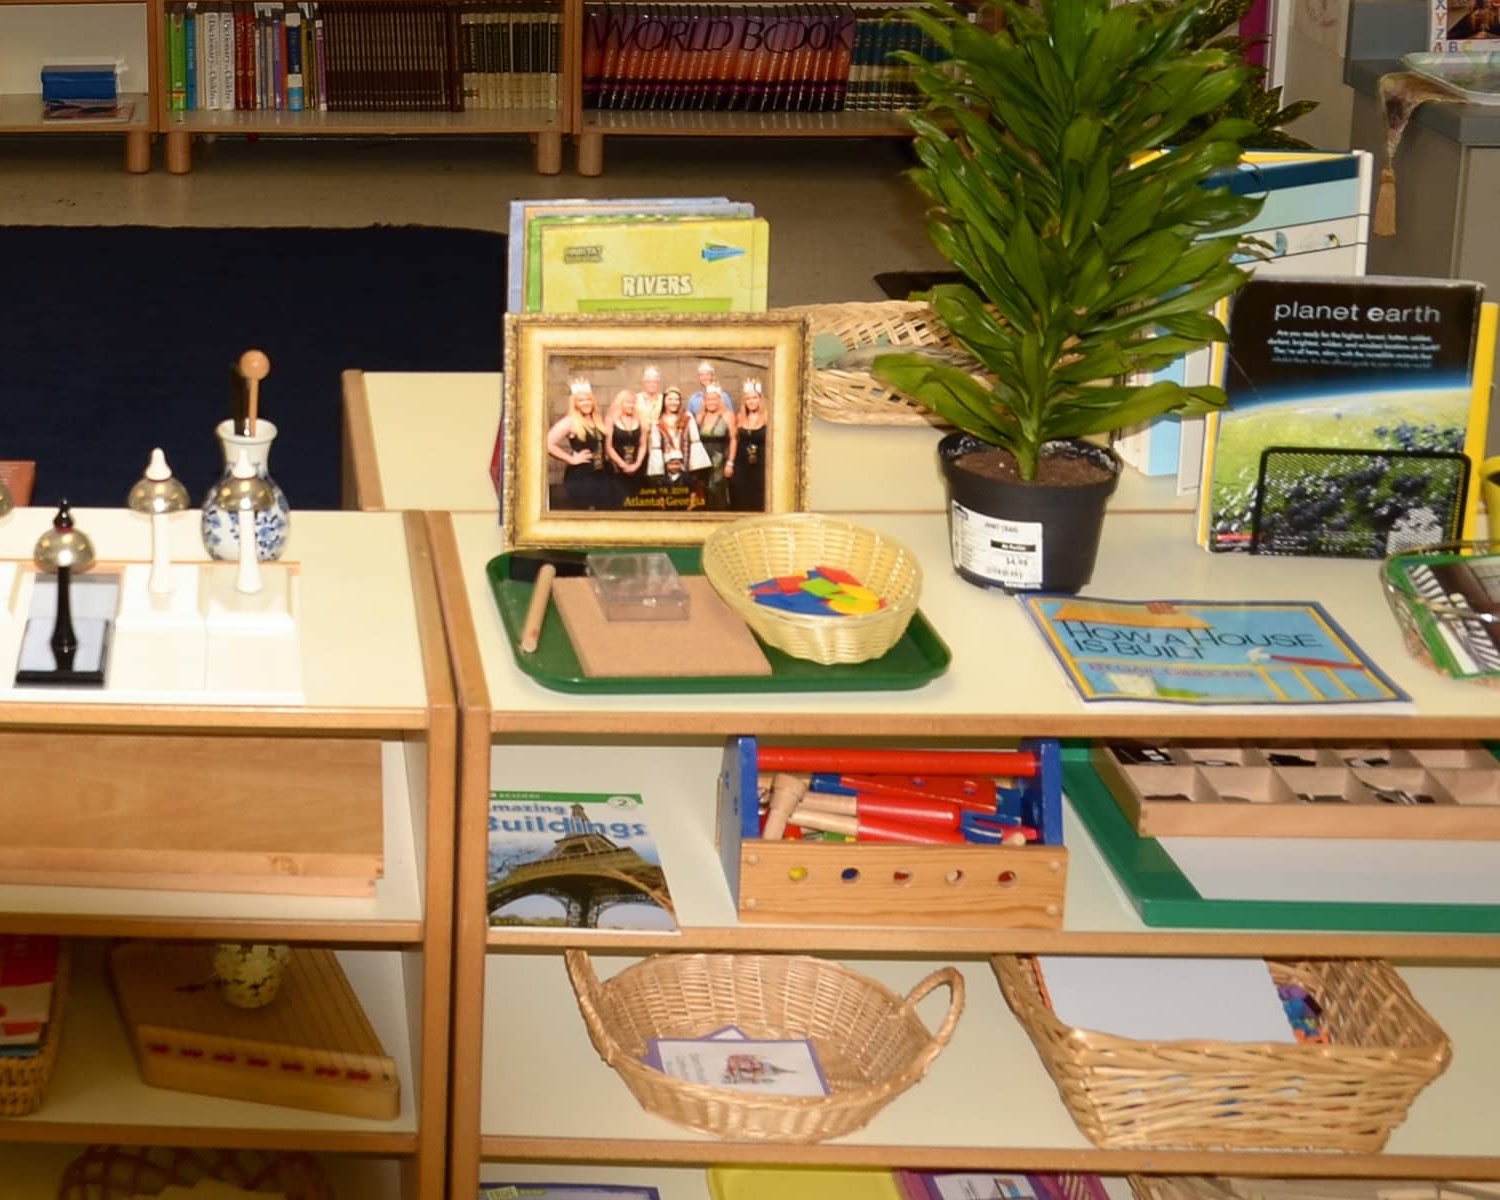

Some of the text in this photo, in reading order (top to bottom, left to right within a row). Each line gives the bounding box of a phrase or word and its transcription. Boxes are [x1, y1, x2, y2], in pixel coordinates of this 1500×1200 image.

[621, 274, 693, 297] RIVERS
[1273, 300, 1442, 324] planet earth
[1061, 617, 1324, 650] HOW A HOUSE
[1073, 638, 1206, 661] IS BUILT
[487, 803, 566, 816] mazing
[617, 798, 629, 809] 2
